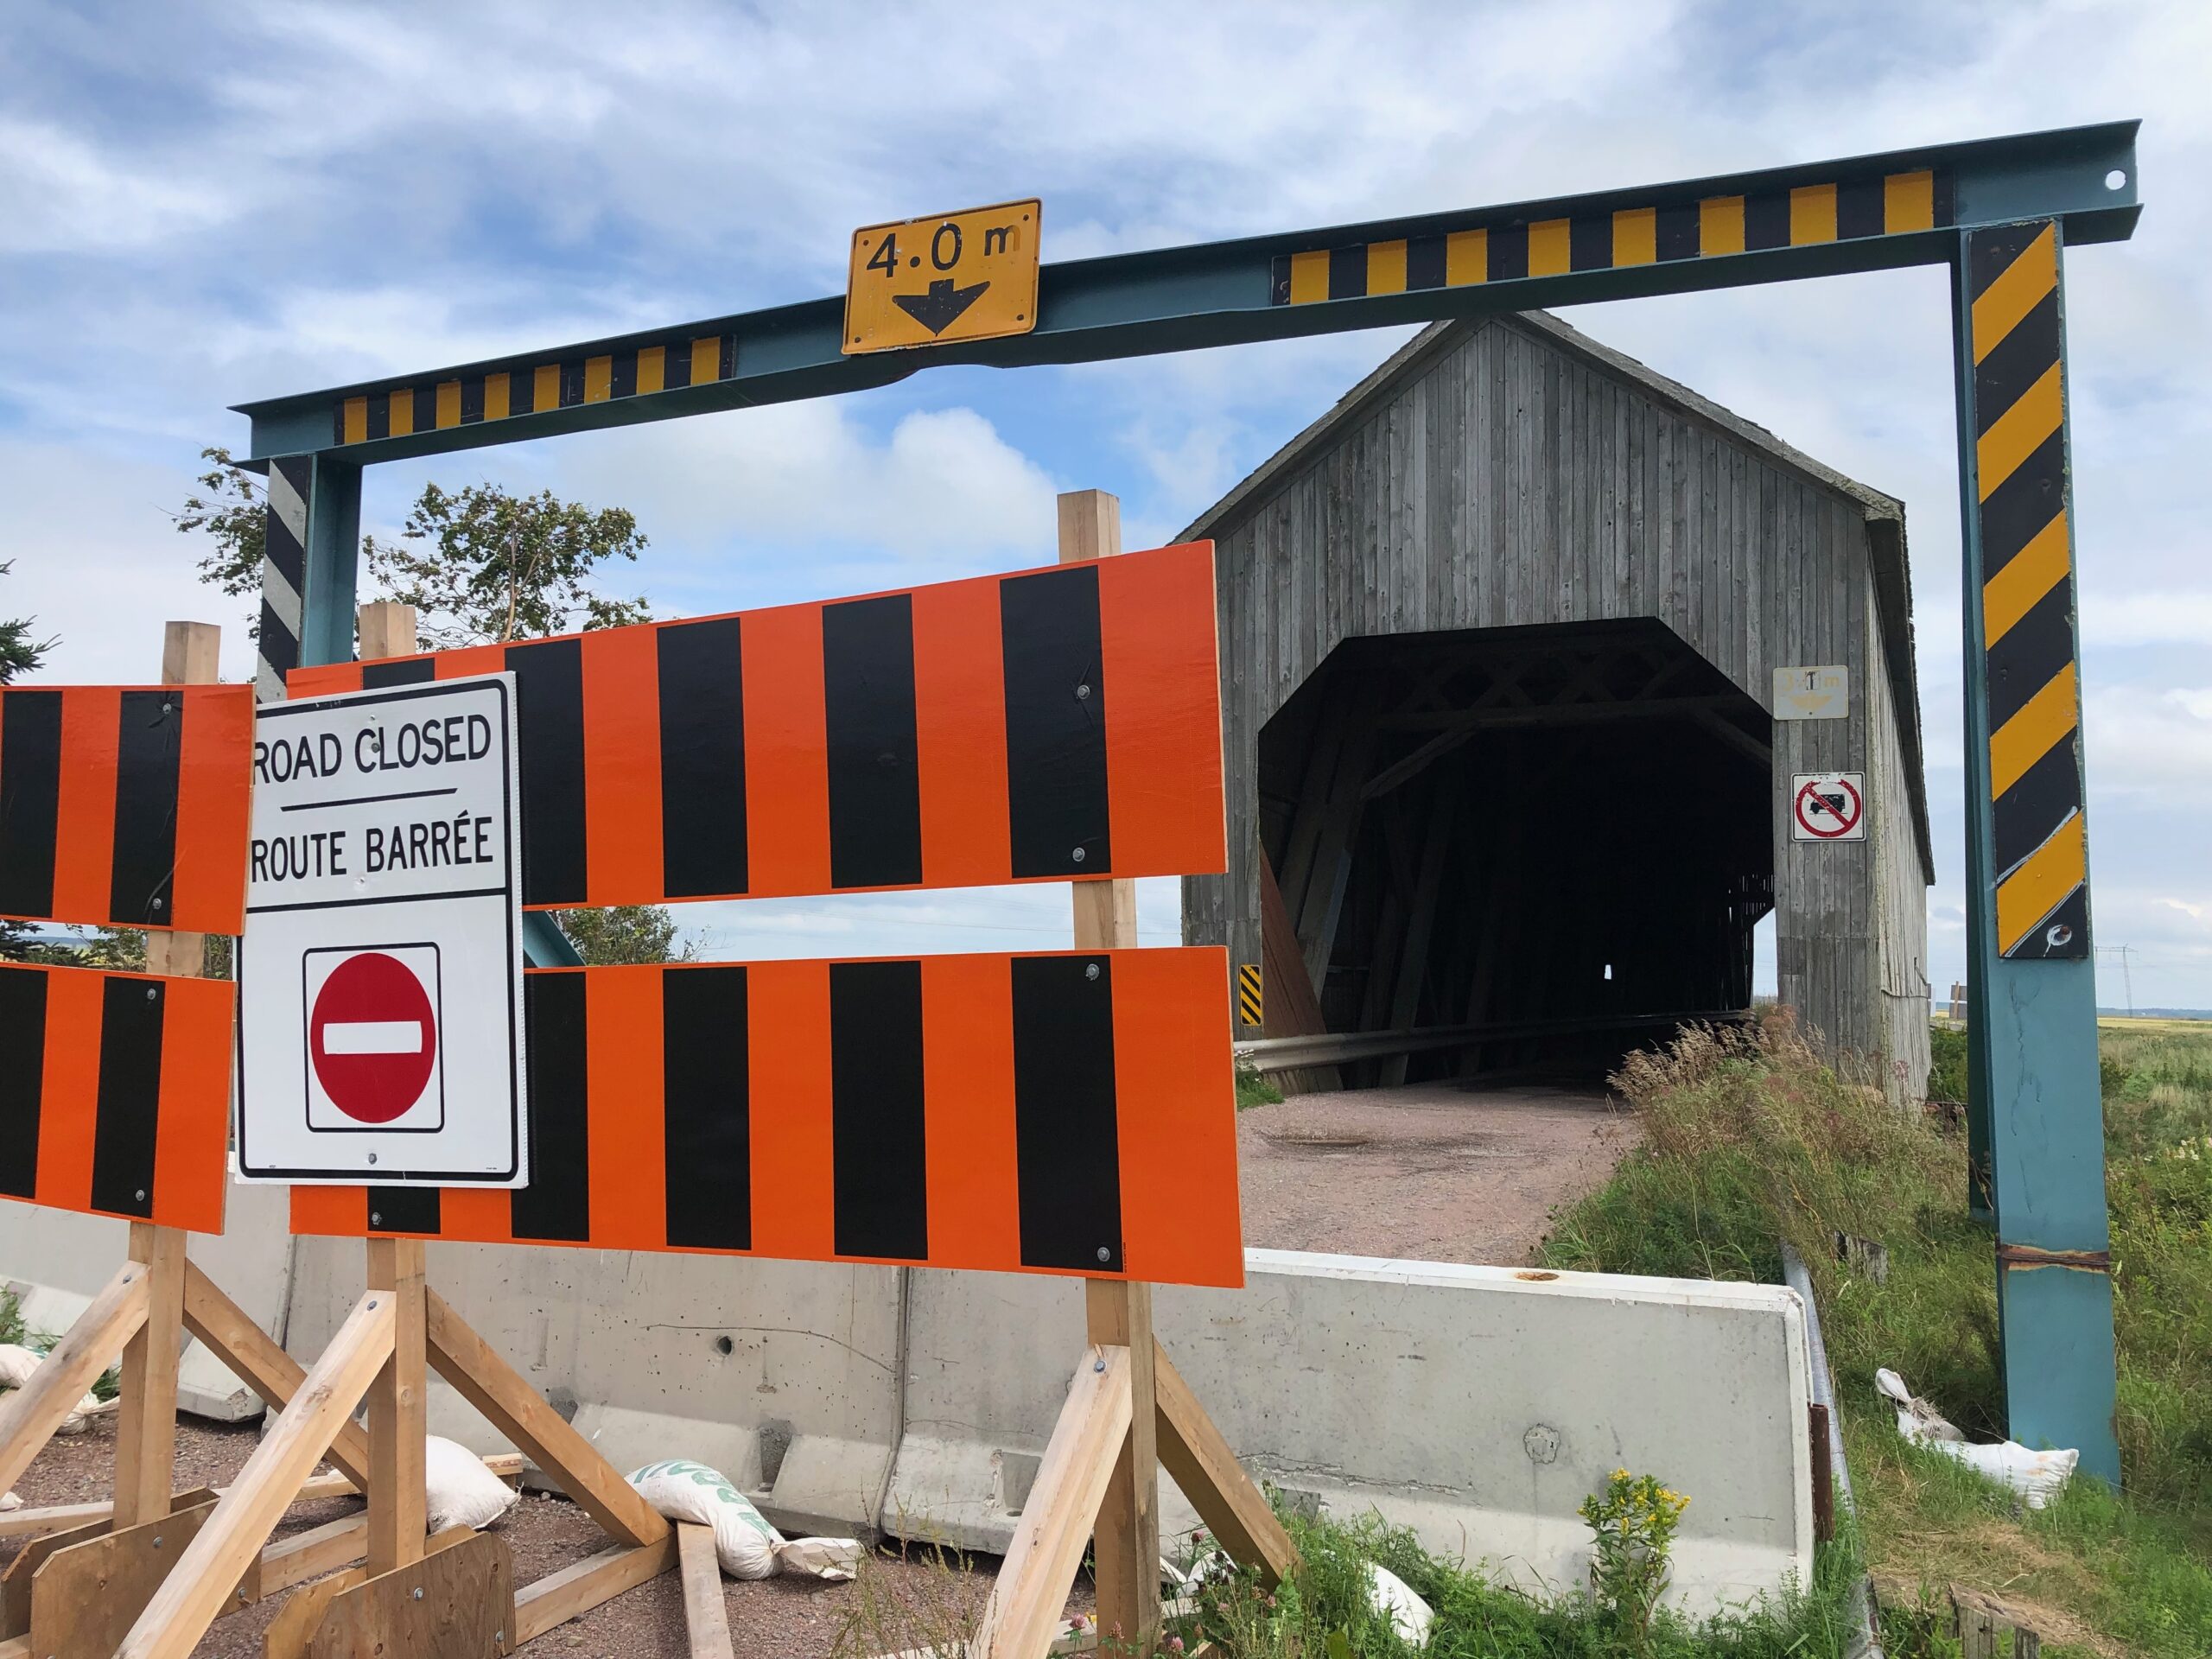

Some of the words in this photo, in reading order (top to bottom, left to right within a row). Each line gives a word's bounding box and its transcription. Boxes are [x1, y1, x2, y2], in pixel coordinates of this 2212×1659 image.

[866, 223, 963, 278] 4.0
[983, 224, 1021, 257] m
[253, 733, 342, 785] ROAD
[354, 714, 492, 773] CLOSED
[251, 830, 347, 883] ROUTE
[365, 809, 493, 873] BARRÉE
